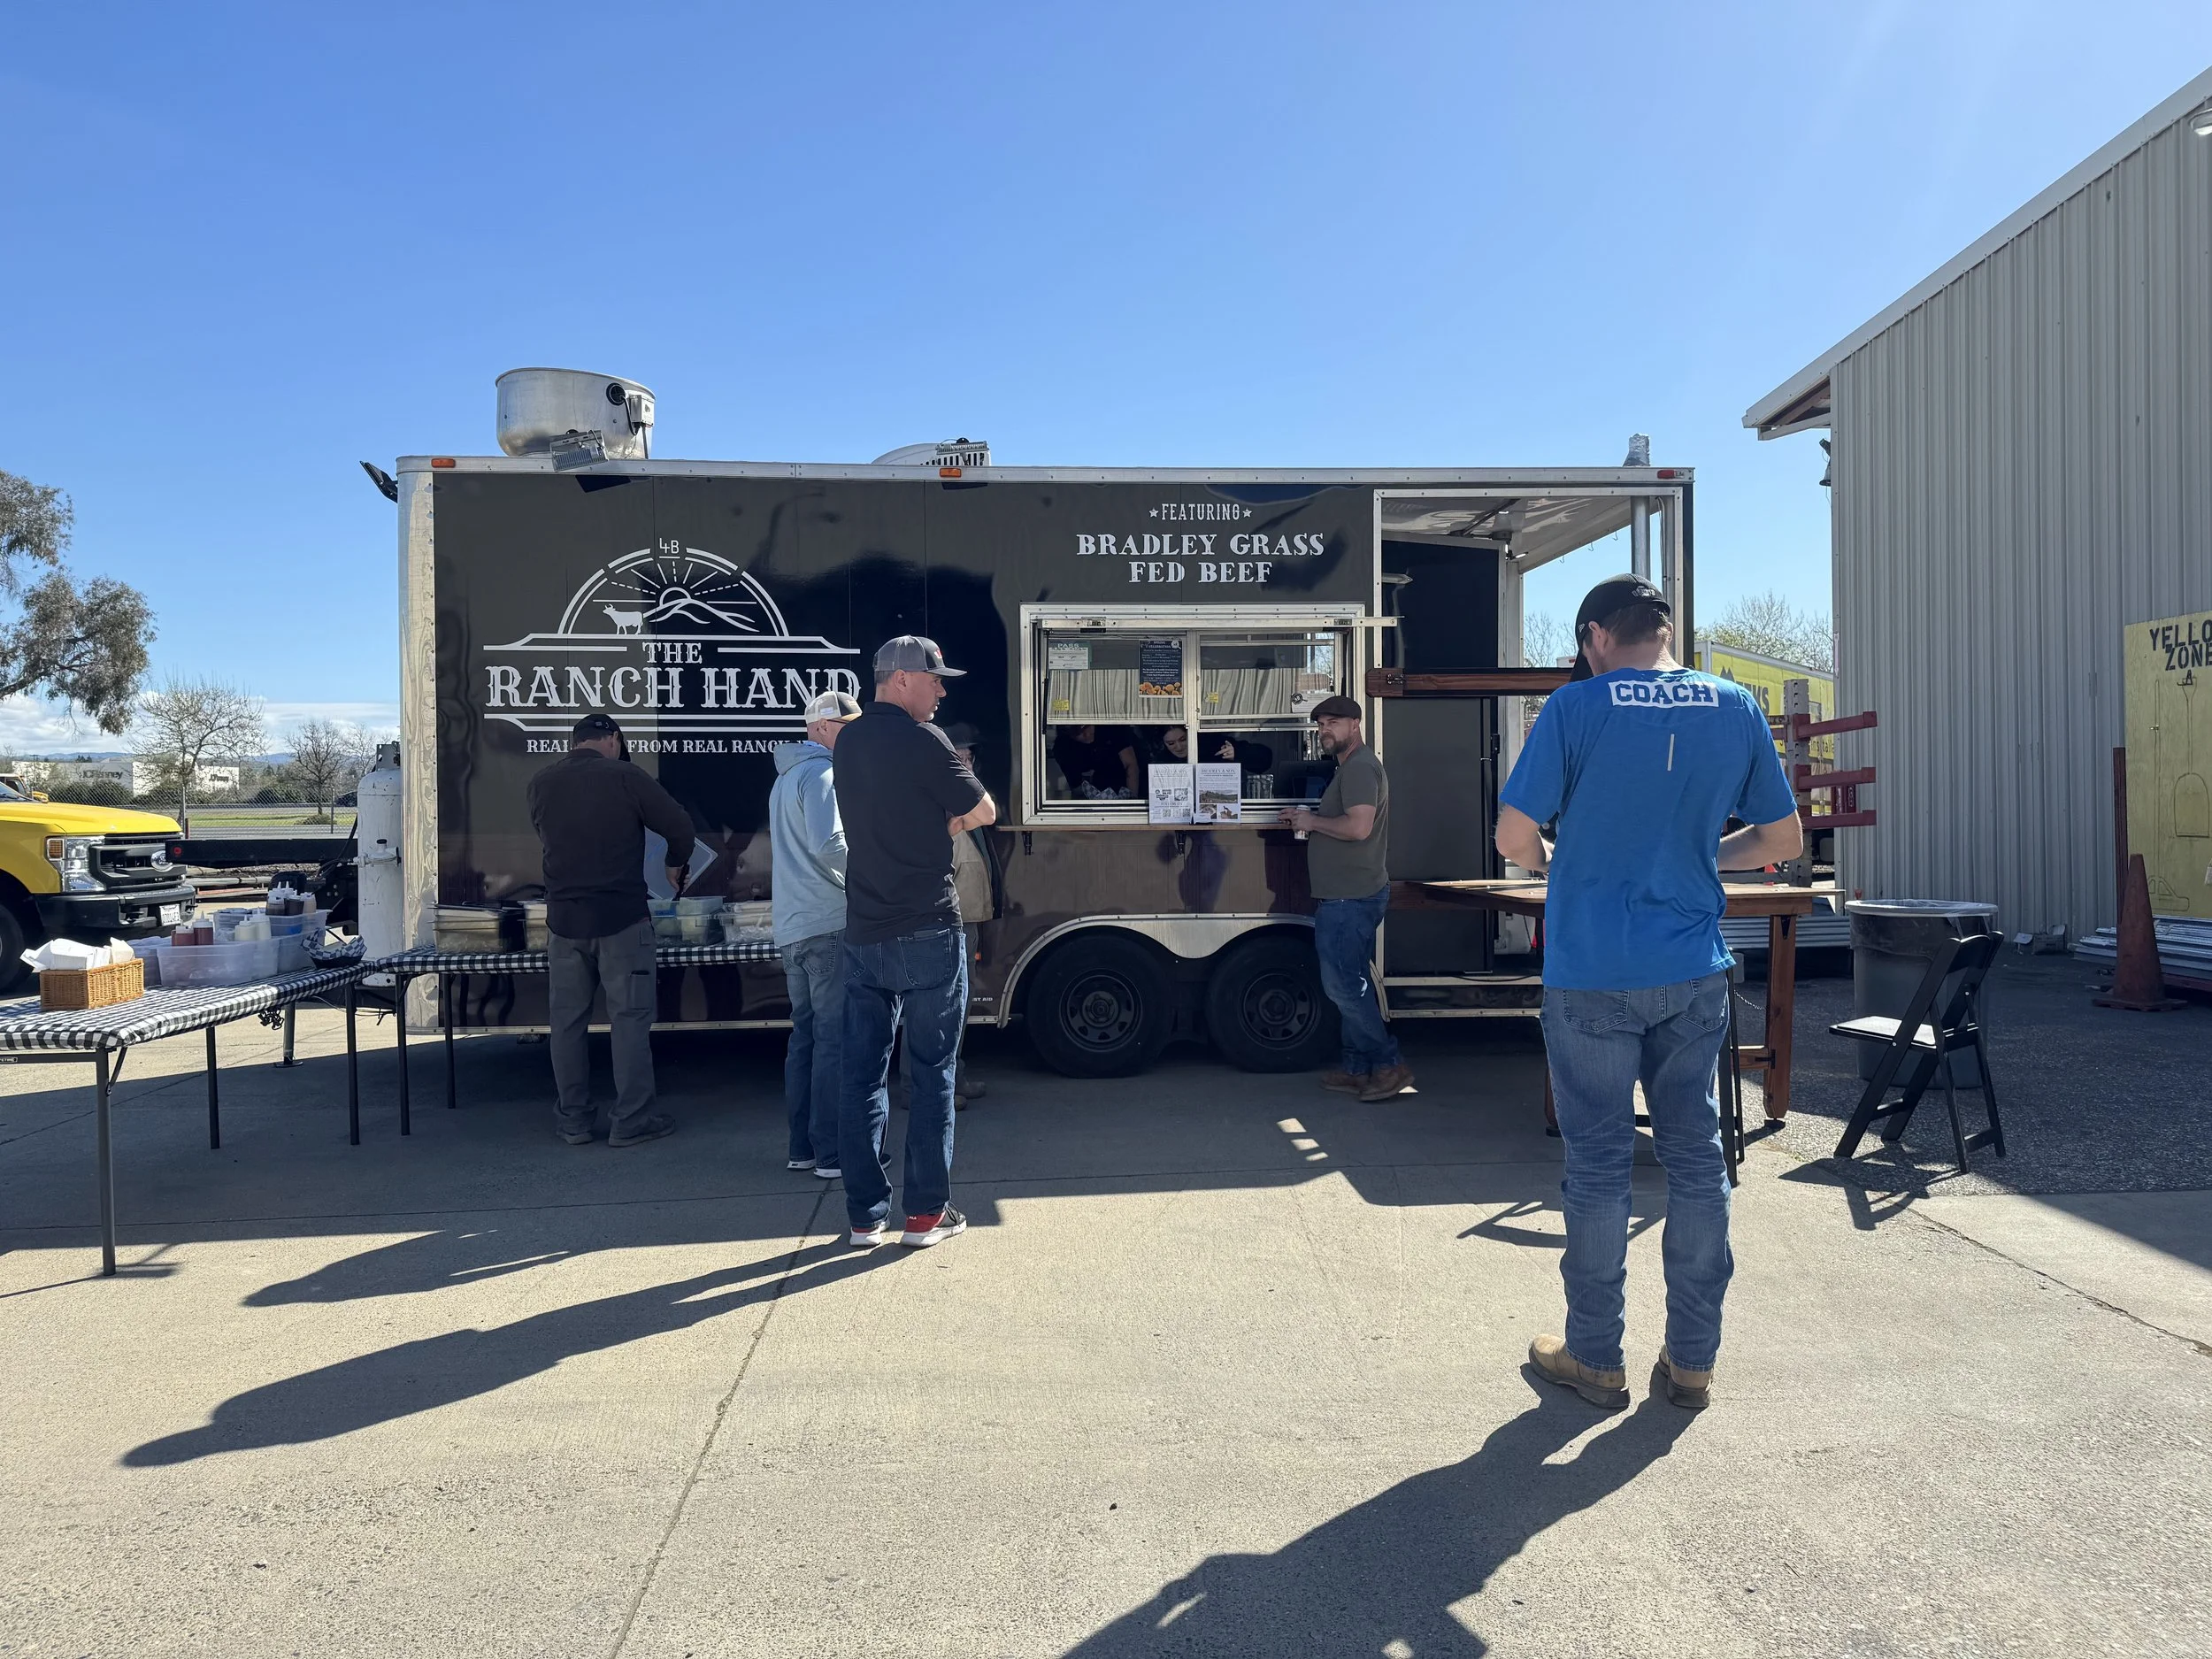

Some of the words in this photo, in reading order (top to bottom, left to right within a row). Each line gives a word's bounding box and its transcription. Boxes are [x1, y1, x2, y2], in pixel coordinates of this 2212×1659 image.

[1161, 503, 1240, 521] FEATURING
[659, 537, 680, 554] 4B
[1076, 534, 1217, 556] BRADLEY
[1229, 533, 1325, 556] GRASS
[1128, 561, 1186, 583] FED
[1197, 561, 1272, 583] BEEF
[2149, 619, 2212, 651] YELLO
[641, 641, 703, 664] THE
[2165, 643, 2212, 671] ZONE
[485, 666, 685, 708] RANCH
[700, 667, 862, 709] HAND
[1615, 683, 1714, 704] COACH
[626, 739, 678, 753] FROM
[682, 740, 728, 753] REAL
[731, 740, 790, 753] RANC
